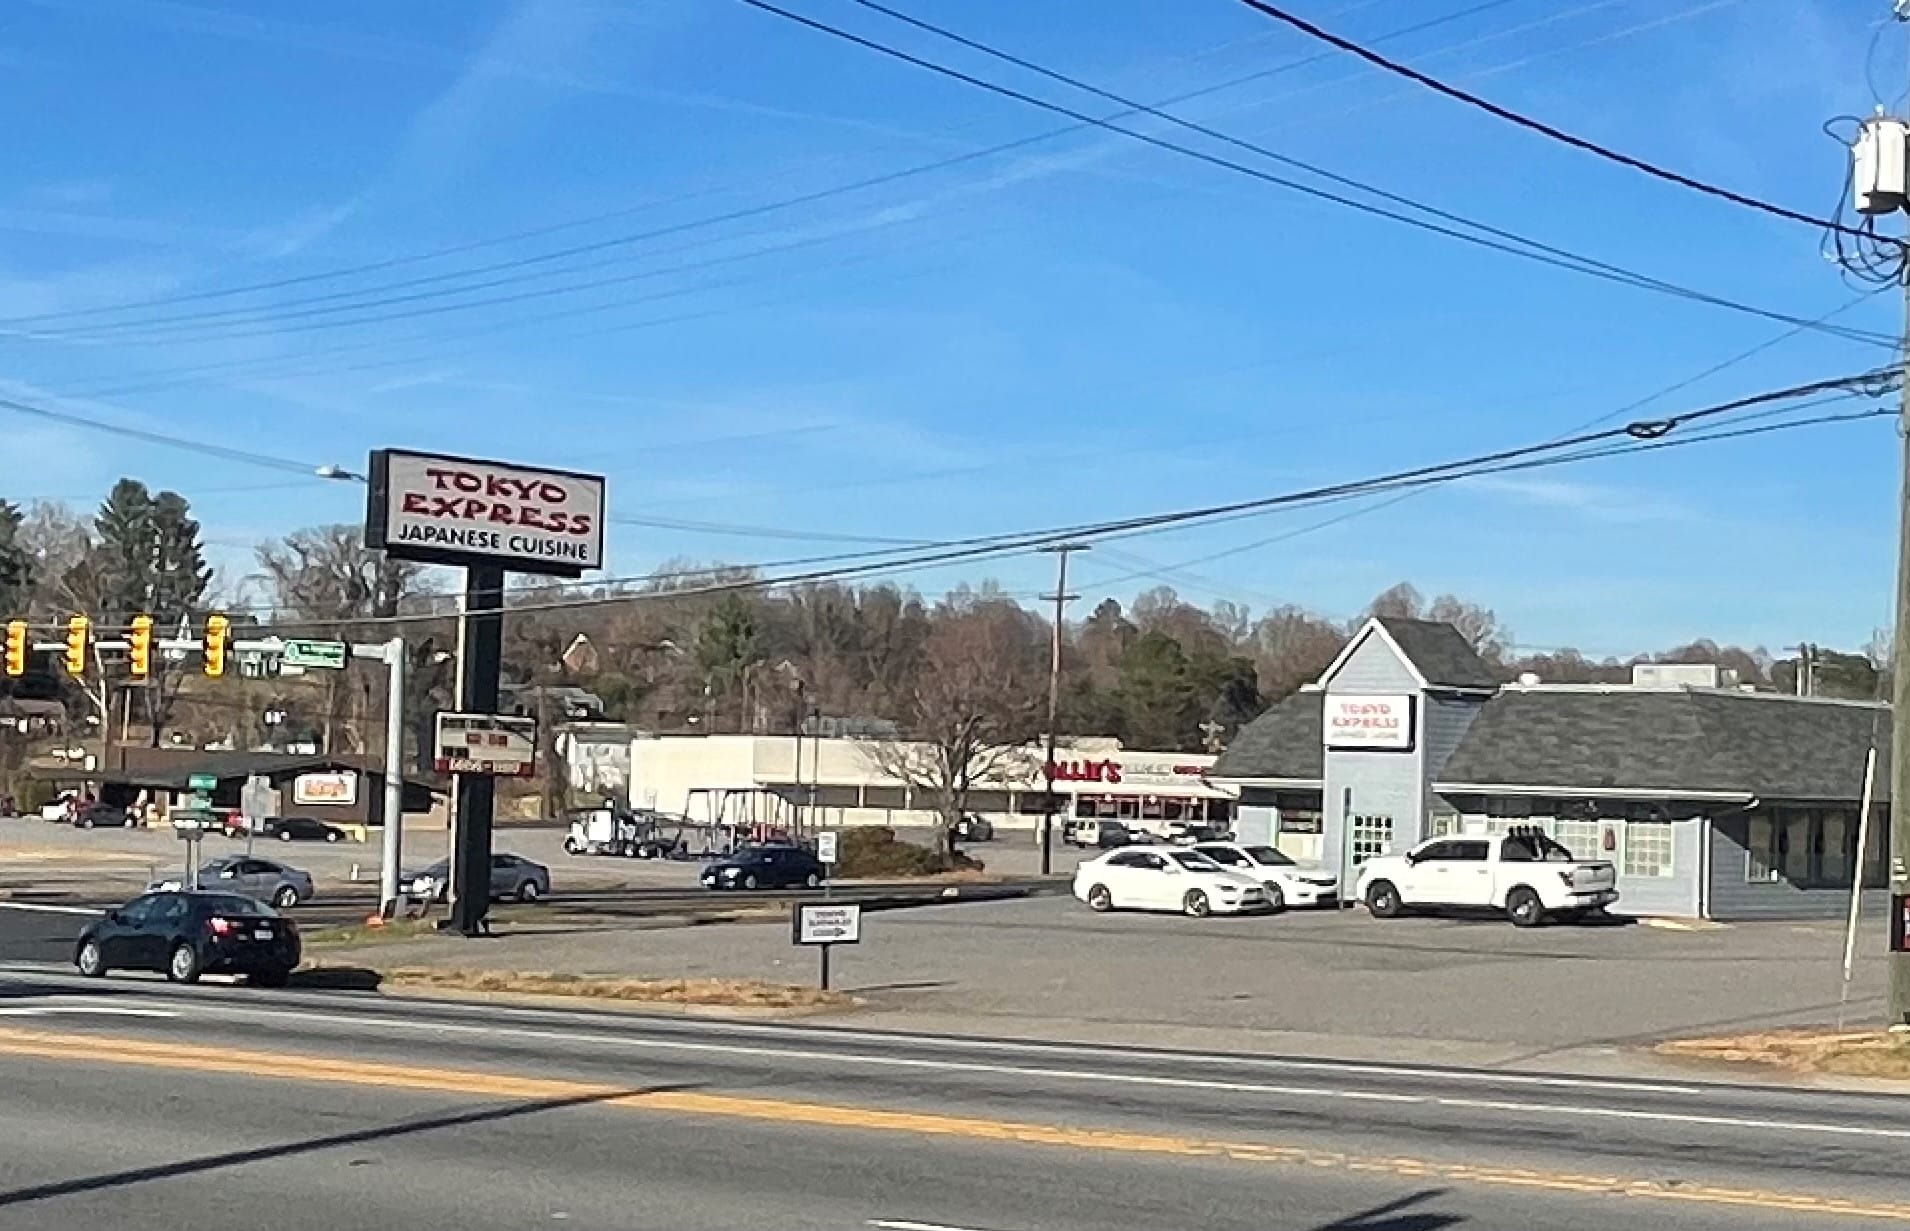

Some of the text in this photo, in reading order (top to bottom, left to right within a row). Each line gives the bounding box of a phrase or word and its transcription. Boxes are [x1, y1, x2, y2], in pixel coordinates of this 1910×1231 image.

[426, 467, 568, 503] TOKYO
[402, 493, 592, 535] EXPRESS
[398, 523, 588, 561] JAPANESE CUISINE
